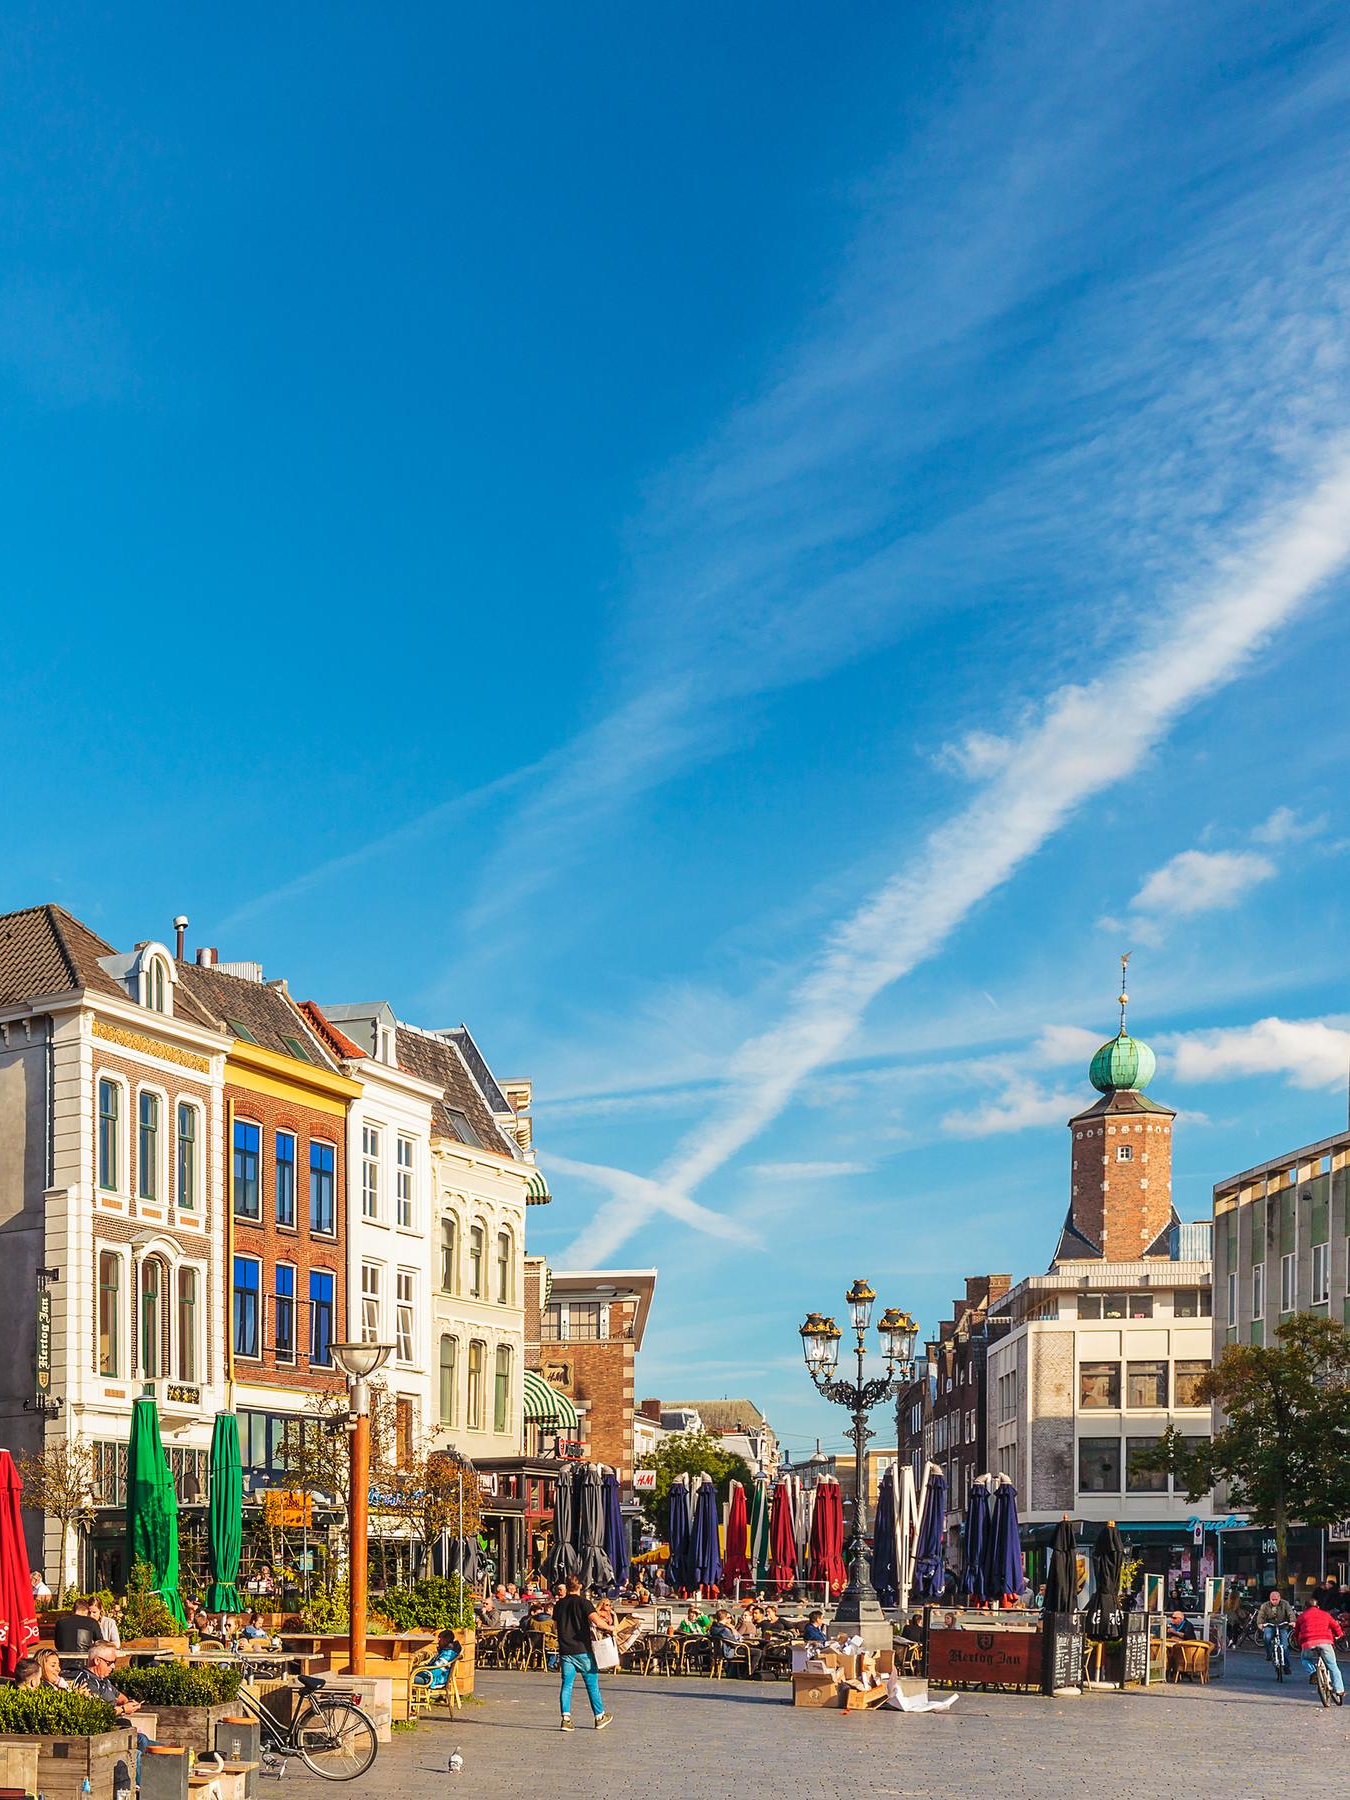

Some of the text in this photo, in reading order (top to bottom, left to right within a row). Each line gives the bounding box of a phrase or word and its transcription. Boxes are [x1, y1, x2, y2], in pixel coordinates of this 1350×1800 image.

[38, 1297, 51, 1369] Hertog Jan
[637, 1474, 654, 1486] H&M
[1186, 1515, 1248, 1535] Duglas
[949, 1649, 1022, 1665] Hertog Jan
